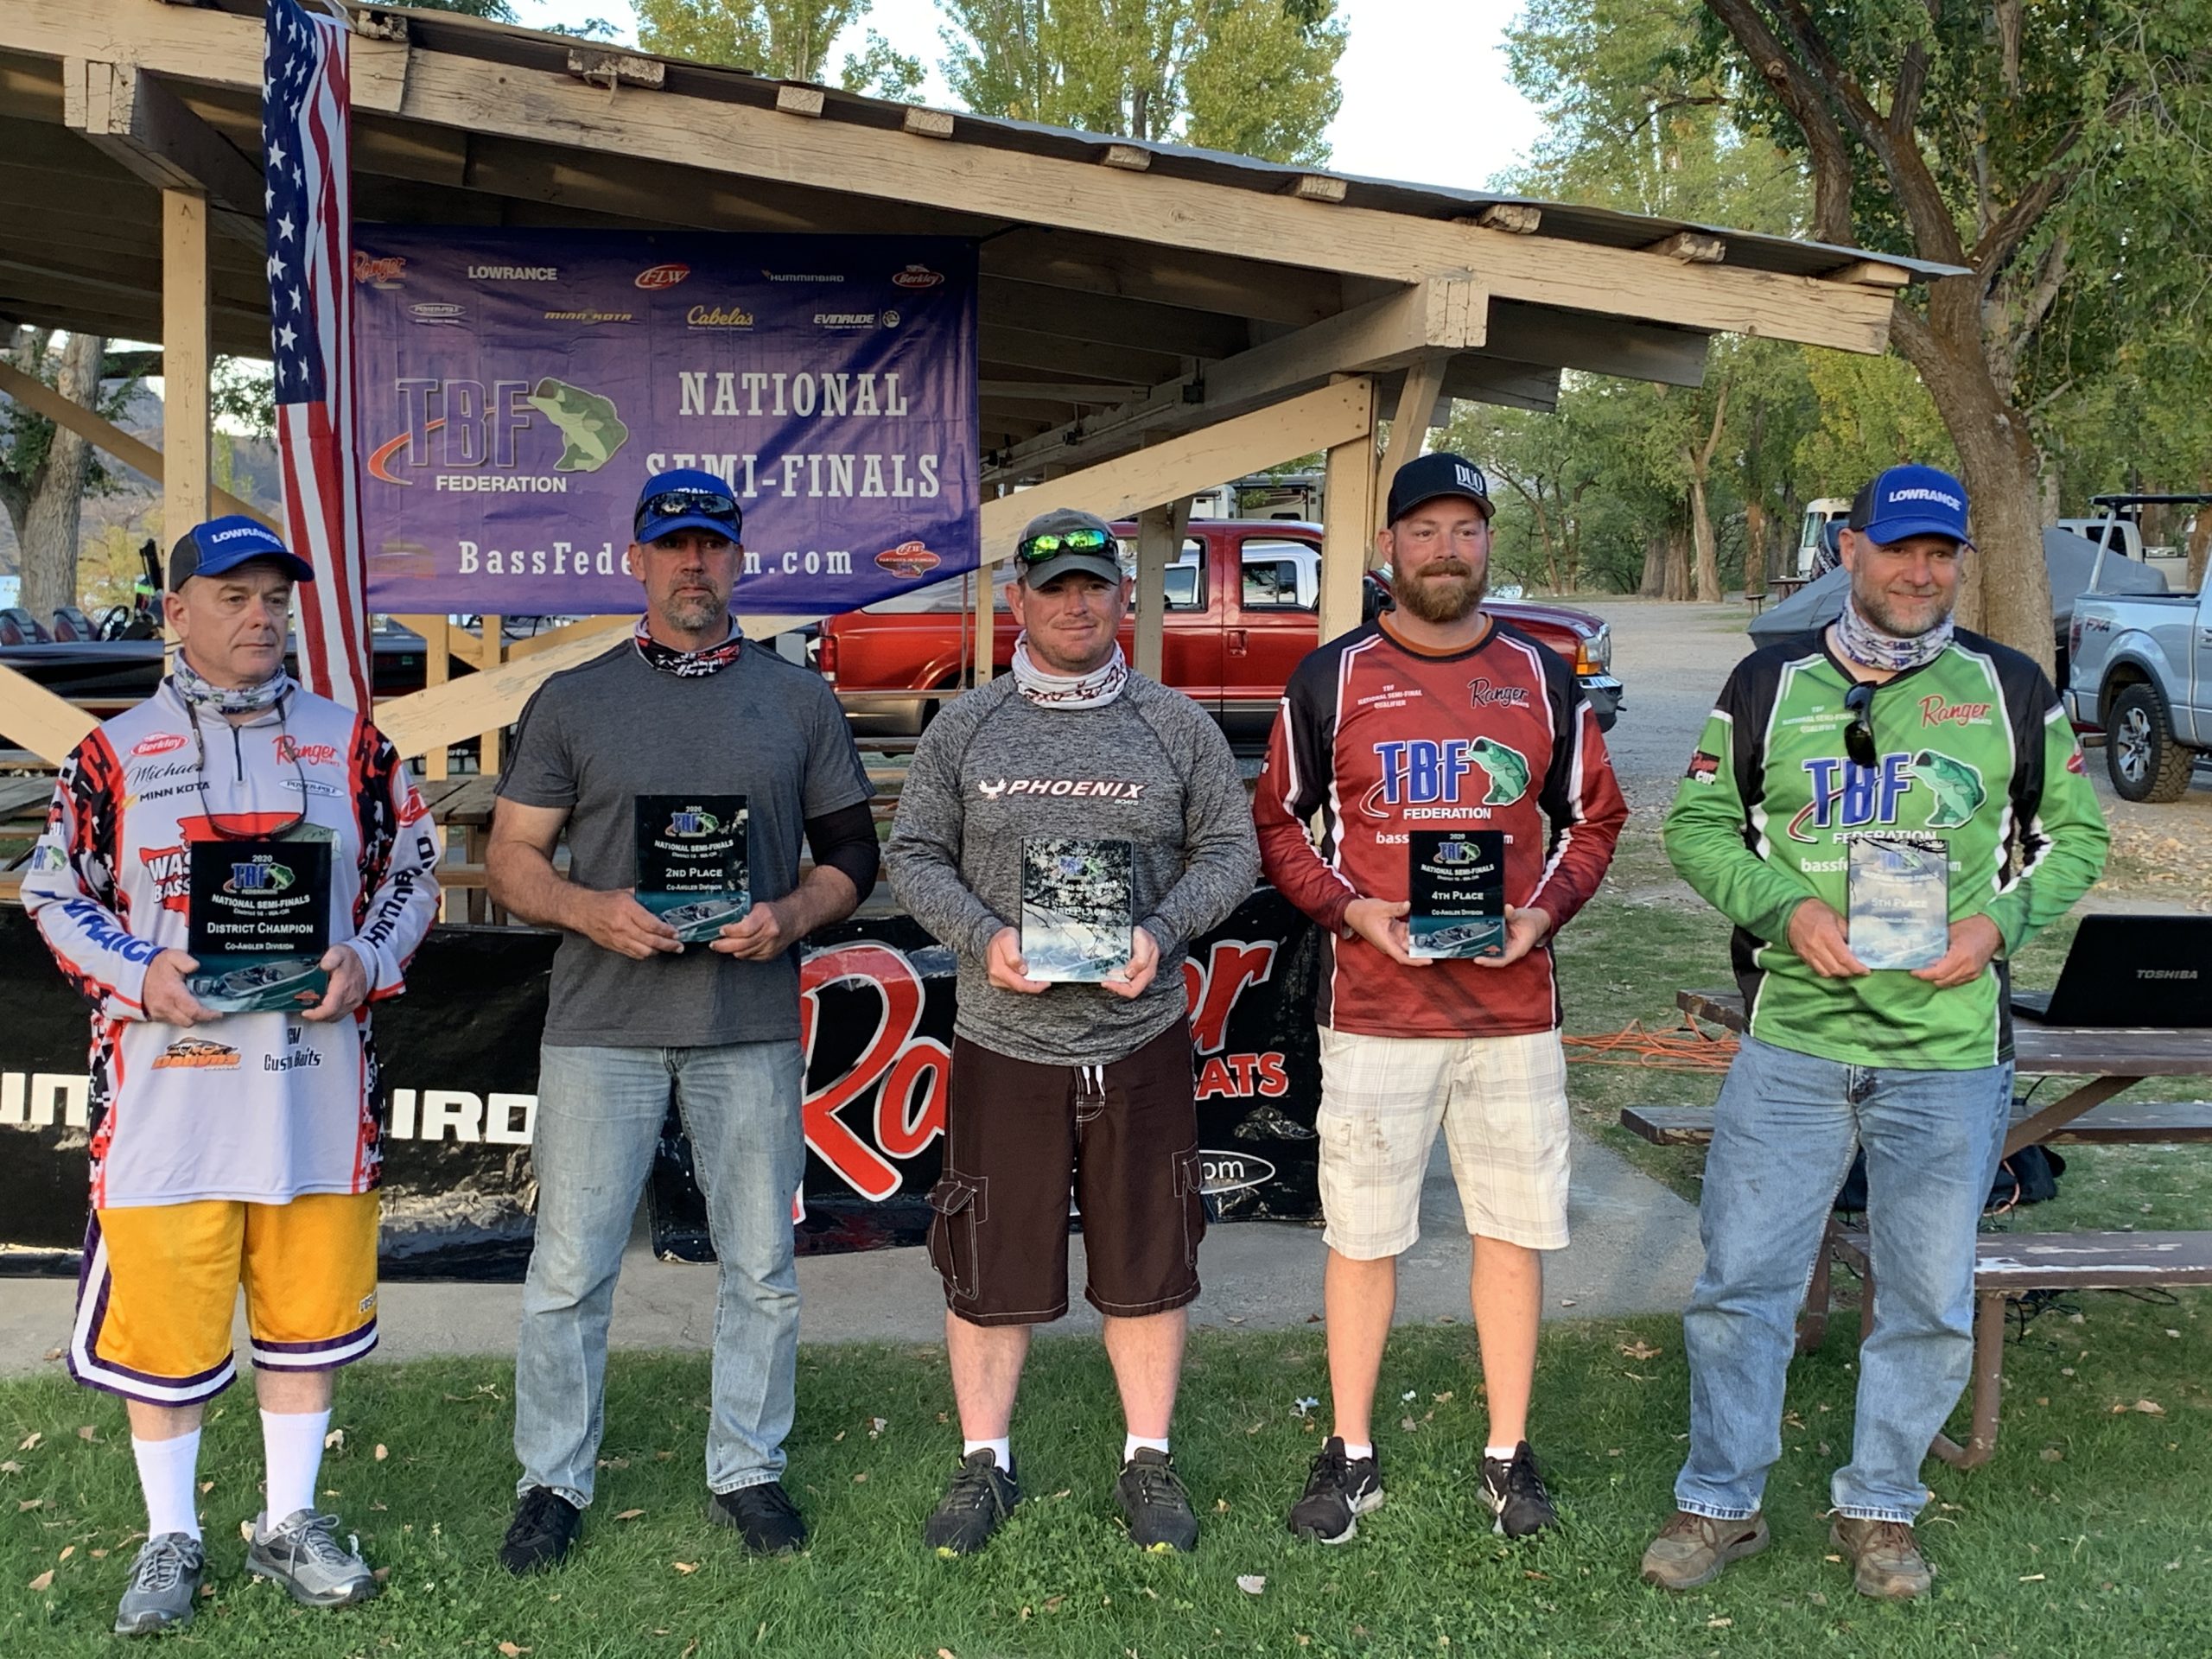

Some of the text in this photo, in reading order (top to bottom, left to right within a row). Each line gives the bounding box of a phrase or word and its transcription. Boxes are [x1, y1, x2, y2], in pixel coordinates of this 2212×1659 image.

[469, 265, 557, 281] LOWRANCE
[643, 268, 690, 284] FLW
[770, 274, 845, 283] HUMMINBIRD
[899, 273, 940, 286] Berkley
[592, 312, 632, 321] KOTA
[687, 304, 754, 326] Cabela's
[813, 314, 875, 324] EVINRUDE
[679, 372, 908, 417] NATIONAL
[395, 378, 530, 467] TBF
[435, 475, 568, 493] FEDERATION
[1454, 463, 1484, 493] DUO
[1889, 488, 1963, 512] LOWRANCE
[211, 528, 283, 549] LOWRANCE
[458, 541, 854, 575] BassFeden.com
[1466, 677, 1529, 709] Ranger
[1918, 694, 1992, 728] Ranger
[137, 737, 183, 754] Berkley
[271, 735, 339, 766] Ranger
[126, 763, 202, 786] Michae
[1373, 739, 1470, 804] TBF
[139, 780, 211, 803] MINN KOTA
[1007, 779, 1146, 798] PHOENIX
[1802, 752, 1912, 828] TBF
[1402, 807, 1492, 820] FEDERATION
[654, 839, 734, 853] NATIONAL SEMI-FINALS
[1833, 830, 1937, 845] FEDERATION
[665, 868, 686, 878] 2ND
[1421, 863, 1454, 875] NATIONAL
[154, 877, 191, 904] BASS
[212, 893, 311, 910] NATIONAL SEMI-FINALS
[2136, 969, 2199, 980] TOSHIBA
[294, 1046, 322, 1068] Baits
[1195, 1052, 1290, 1102] ATS
